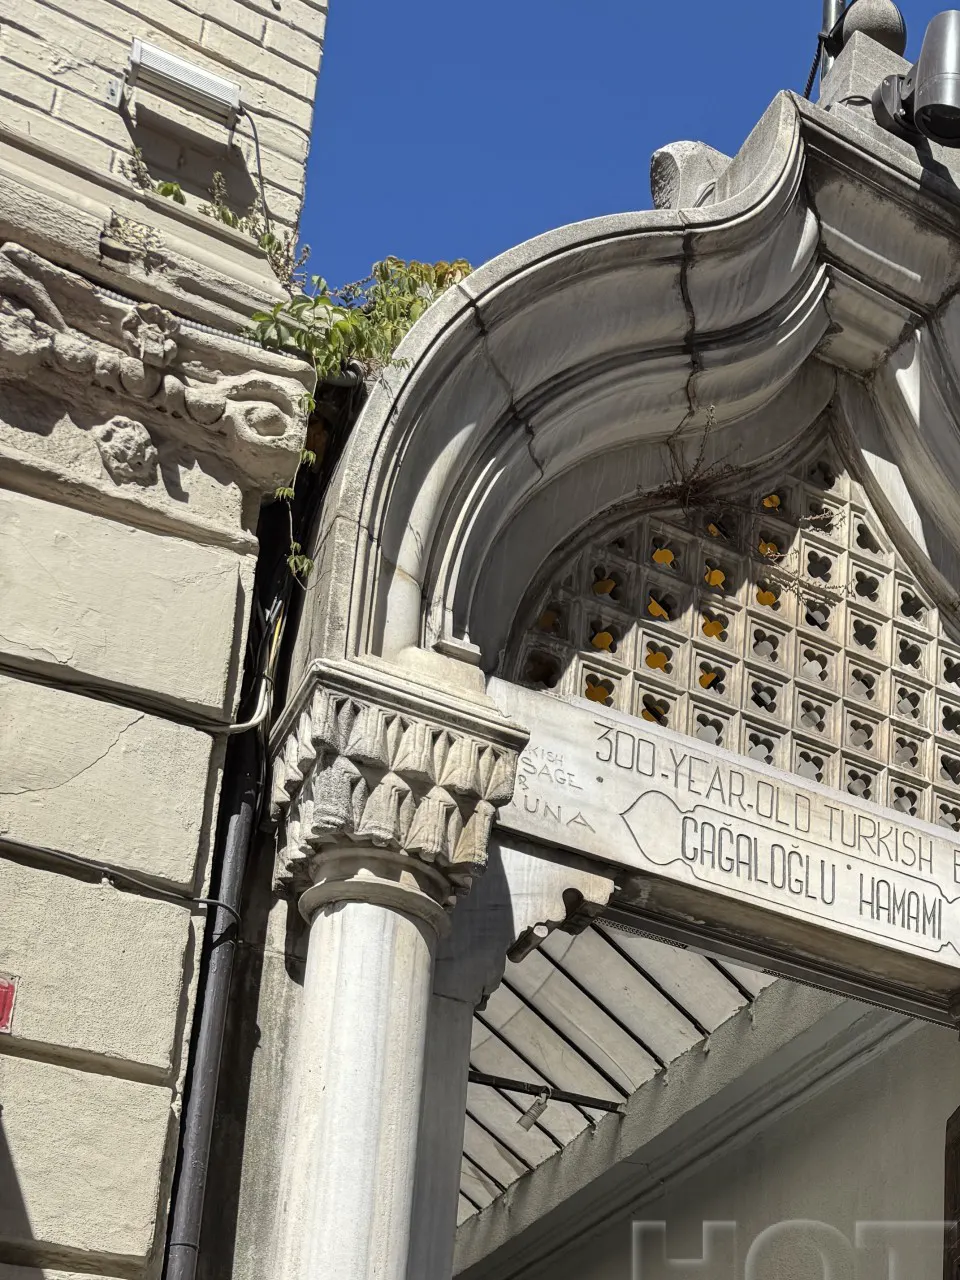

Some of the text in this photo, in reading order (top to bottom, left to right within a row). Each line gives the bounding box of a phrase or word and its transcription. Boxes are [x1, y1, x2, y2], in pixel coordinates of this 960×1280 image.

[512, 794, 596, 834] UNA
[823, 804, 933, 874] TURKISH
[858, 872, 942, 941] HAMAMI
